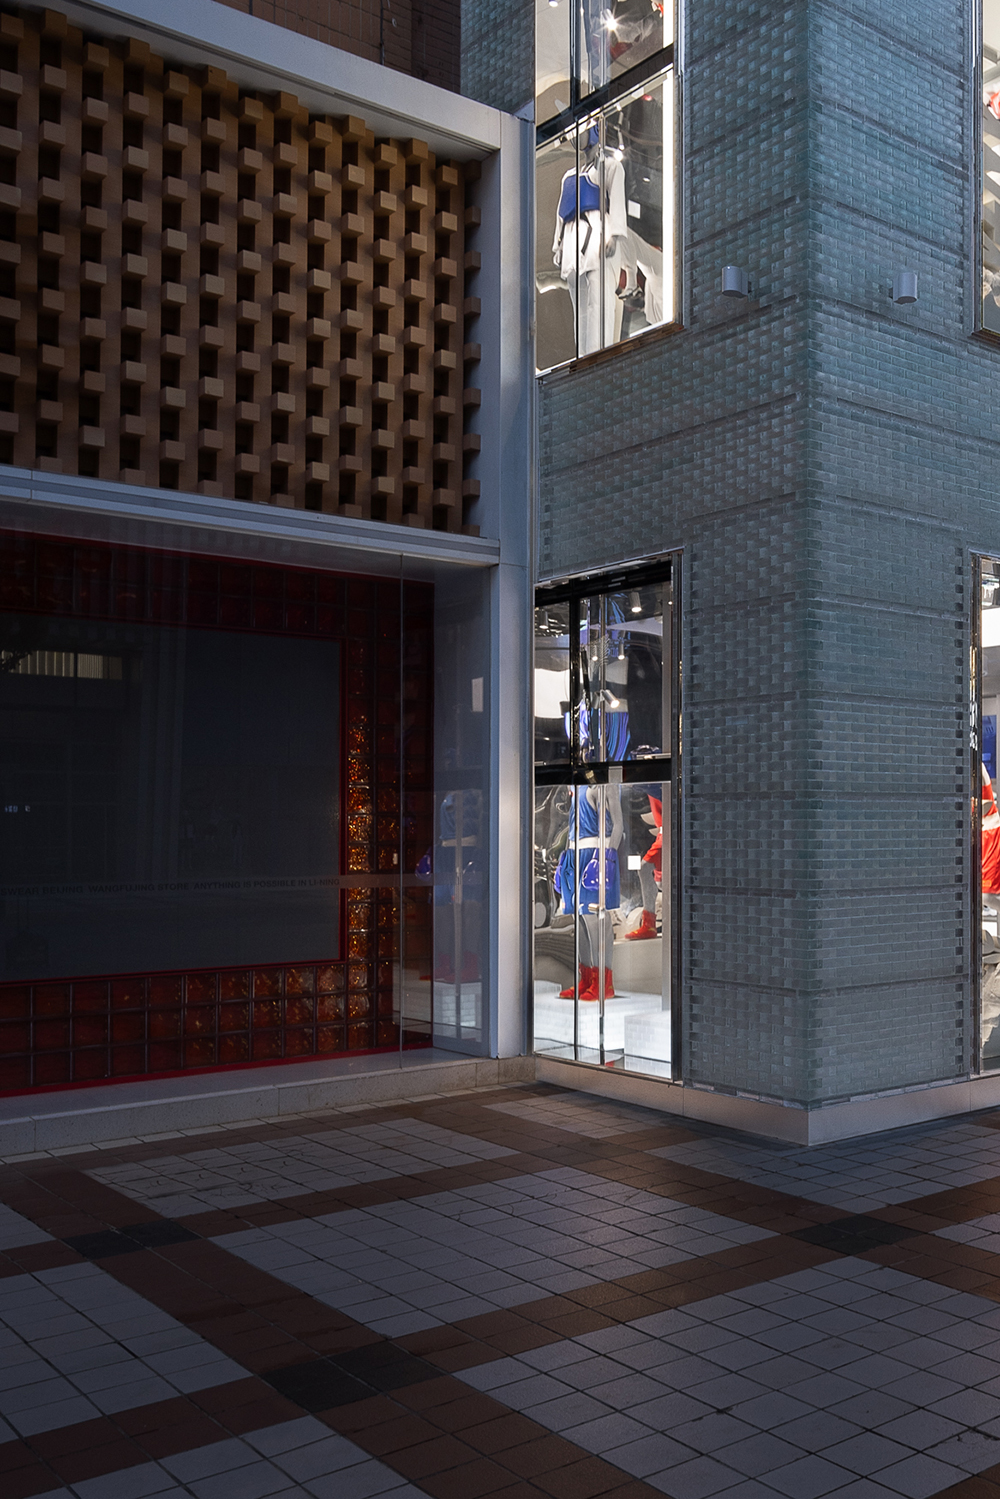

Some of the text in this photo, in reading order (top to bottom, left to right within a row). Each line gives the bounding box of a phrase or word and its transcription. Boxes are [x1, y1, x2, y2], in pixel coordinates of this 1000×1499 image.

[42, 885, 84, 895] BEIJING
[88, 883, 155, 893] WANGFUJING
[157, 882, 190, 892] STORE
[243, 880, 252, 888] IS
[253, 879, 296, 888] POSSIBLE
[297, 879, 307, 887] IN
[308, 878, 340, 887] LI-NING
